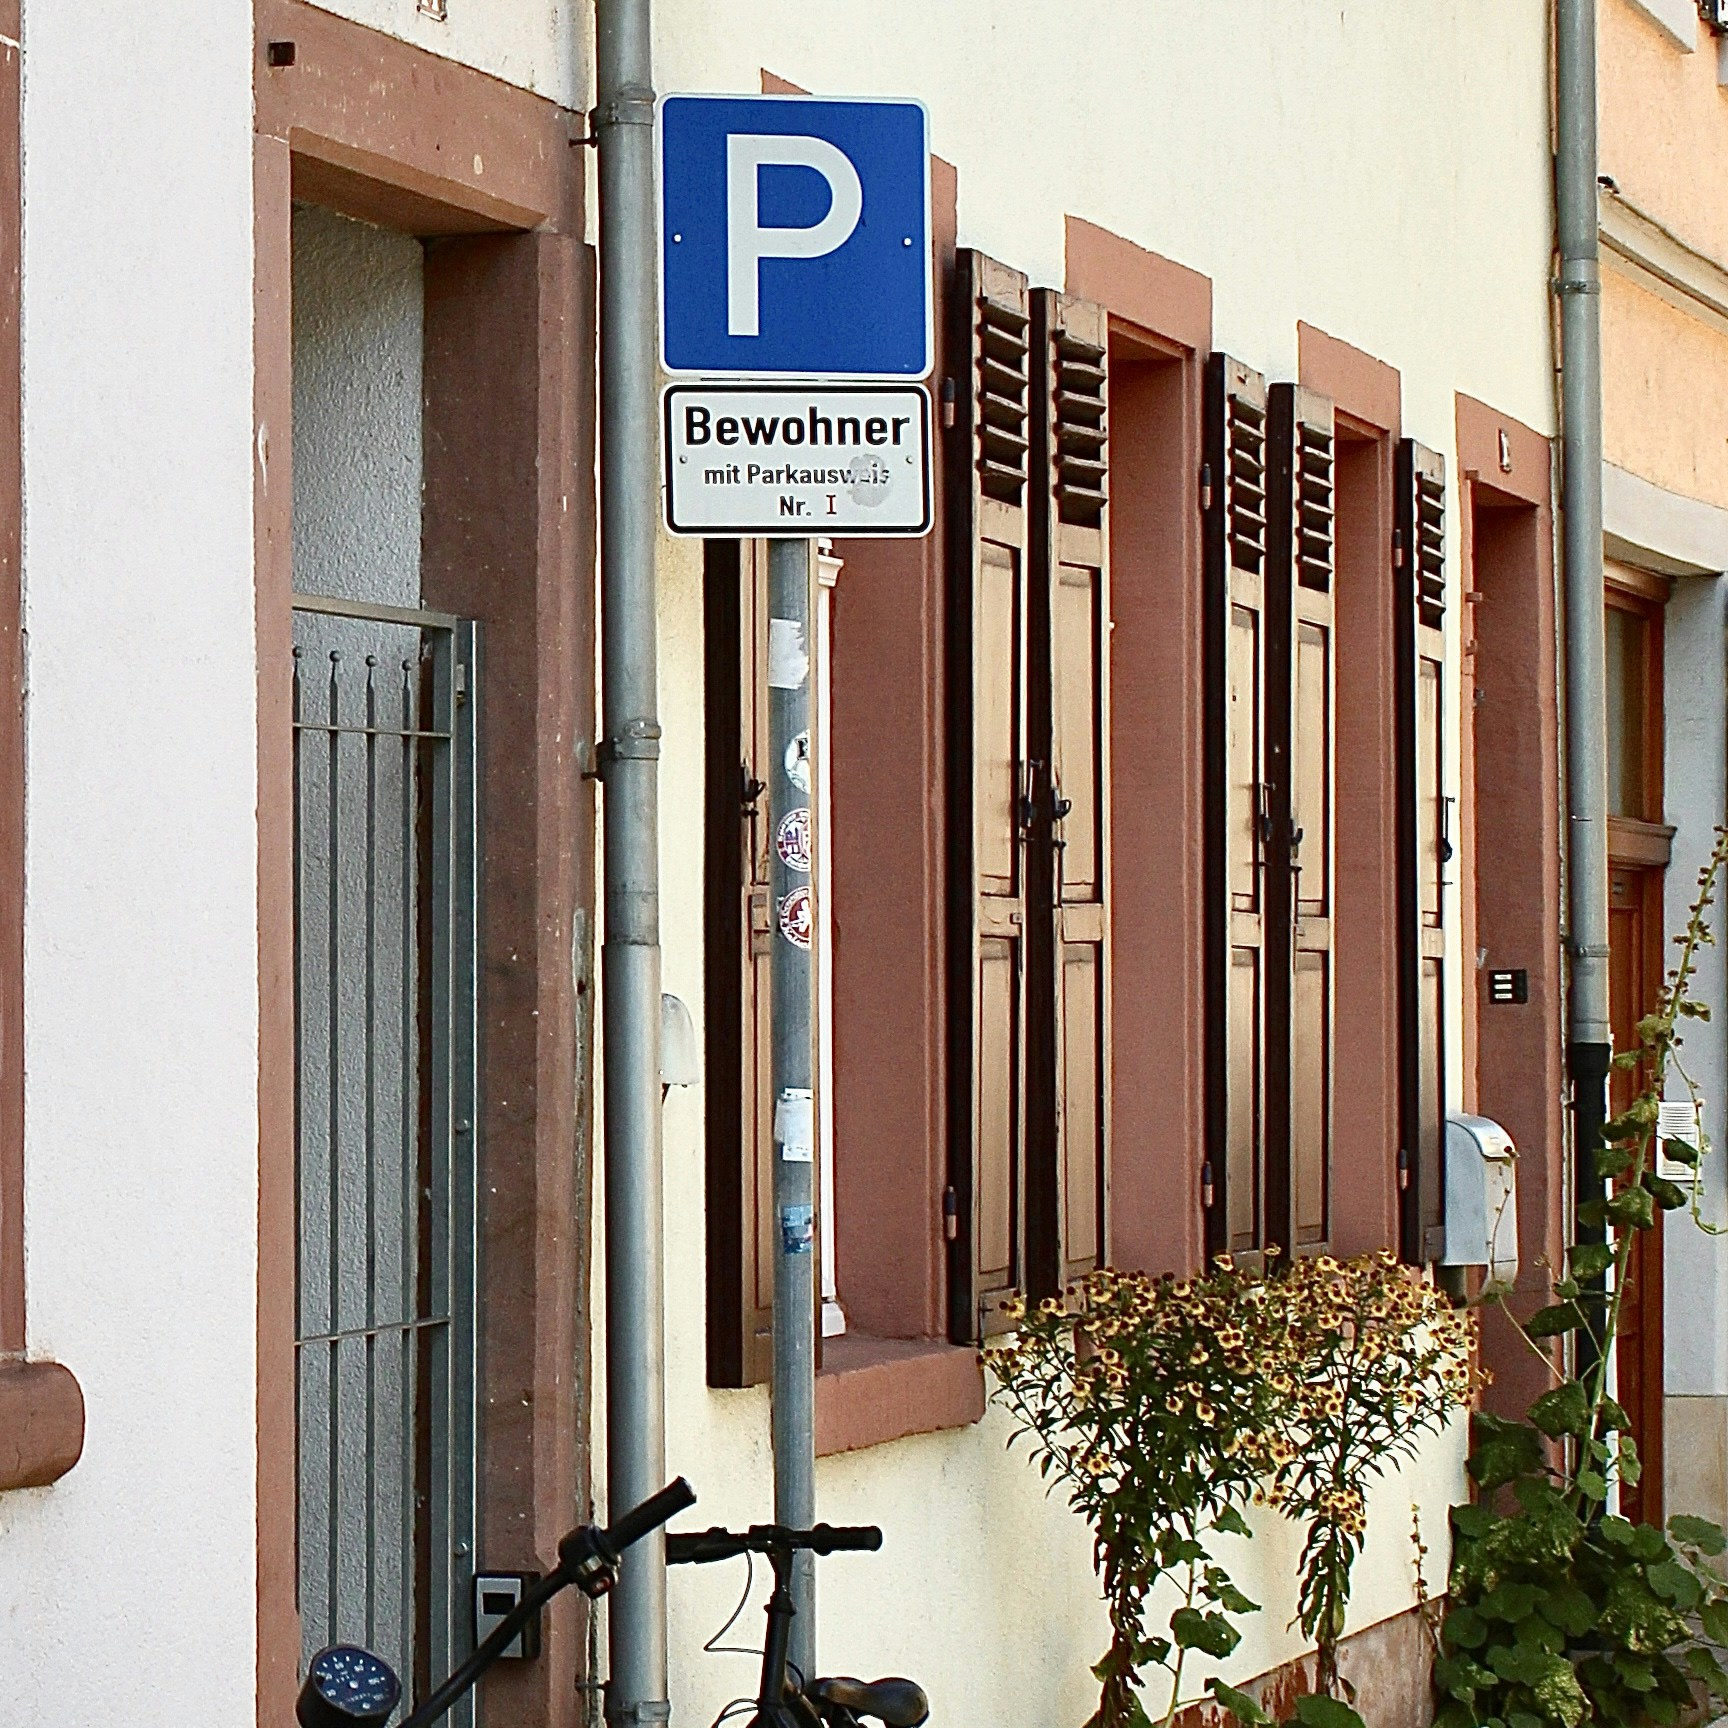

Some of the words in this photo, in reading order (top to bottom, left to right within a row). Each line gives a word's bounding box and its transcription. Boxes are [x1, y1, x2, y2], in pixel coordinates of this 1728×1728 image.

[727, 133, 863, 336] P
[685, 405, 911, 446] Bewohner
[704, 464, 741, 484] mit
[780, 495, 812, 516] Nr.
